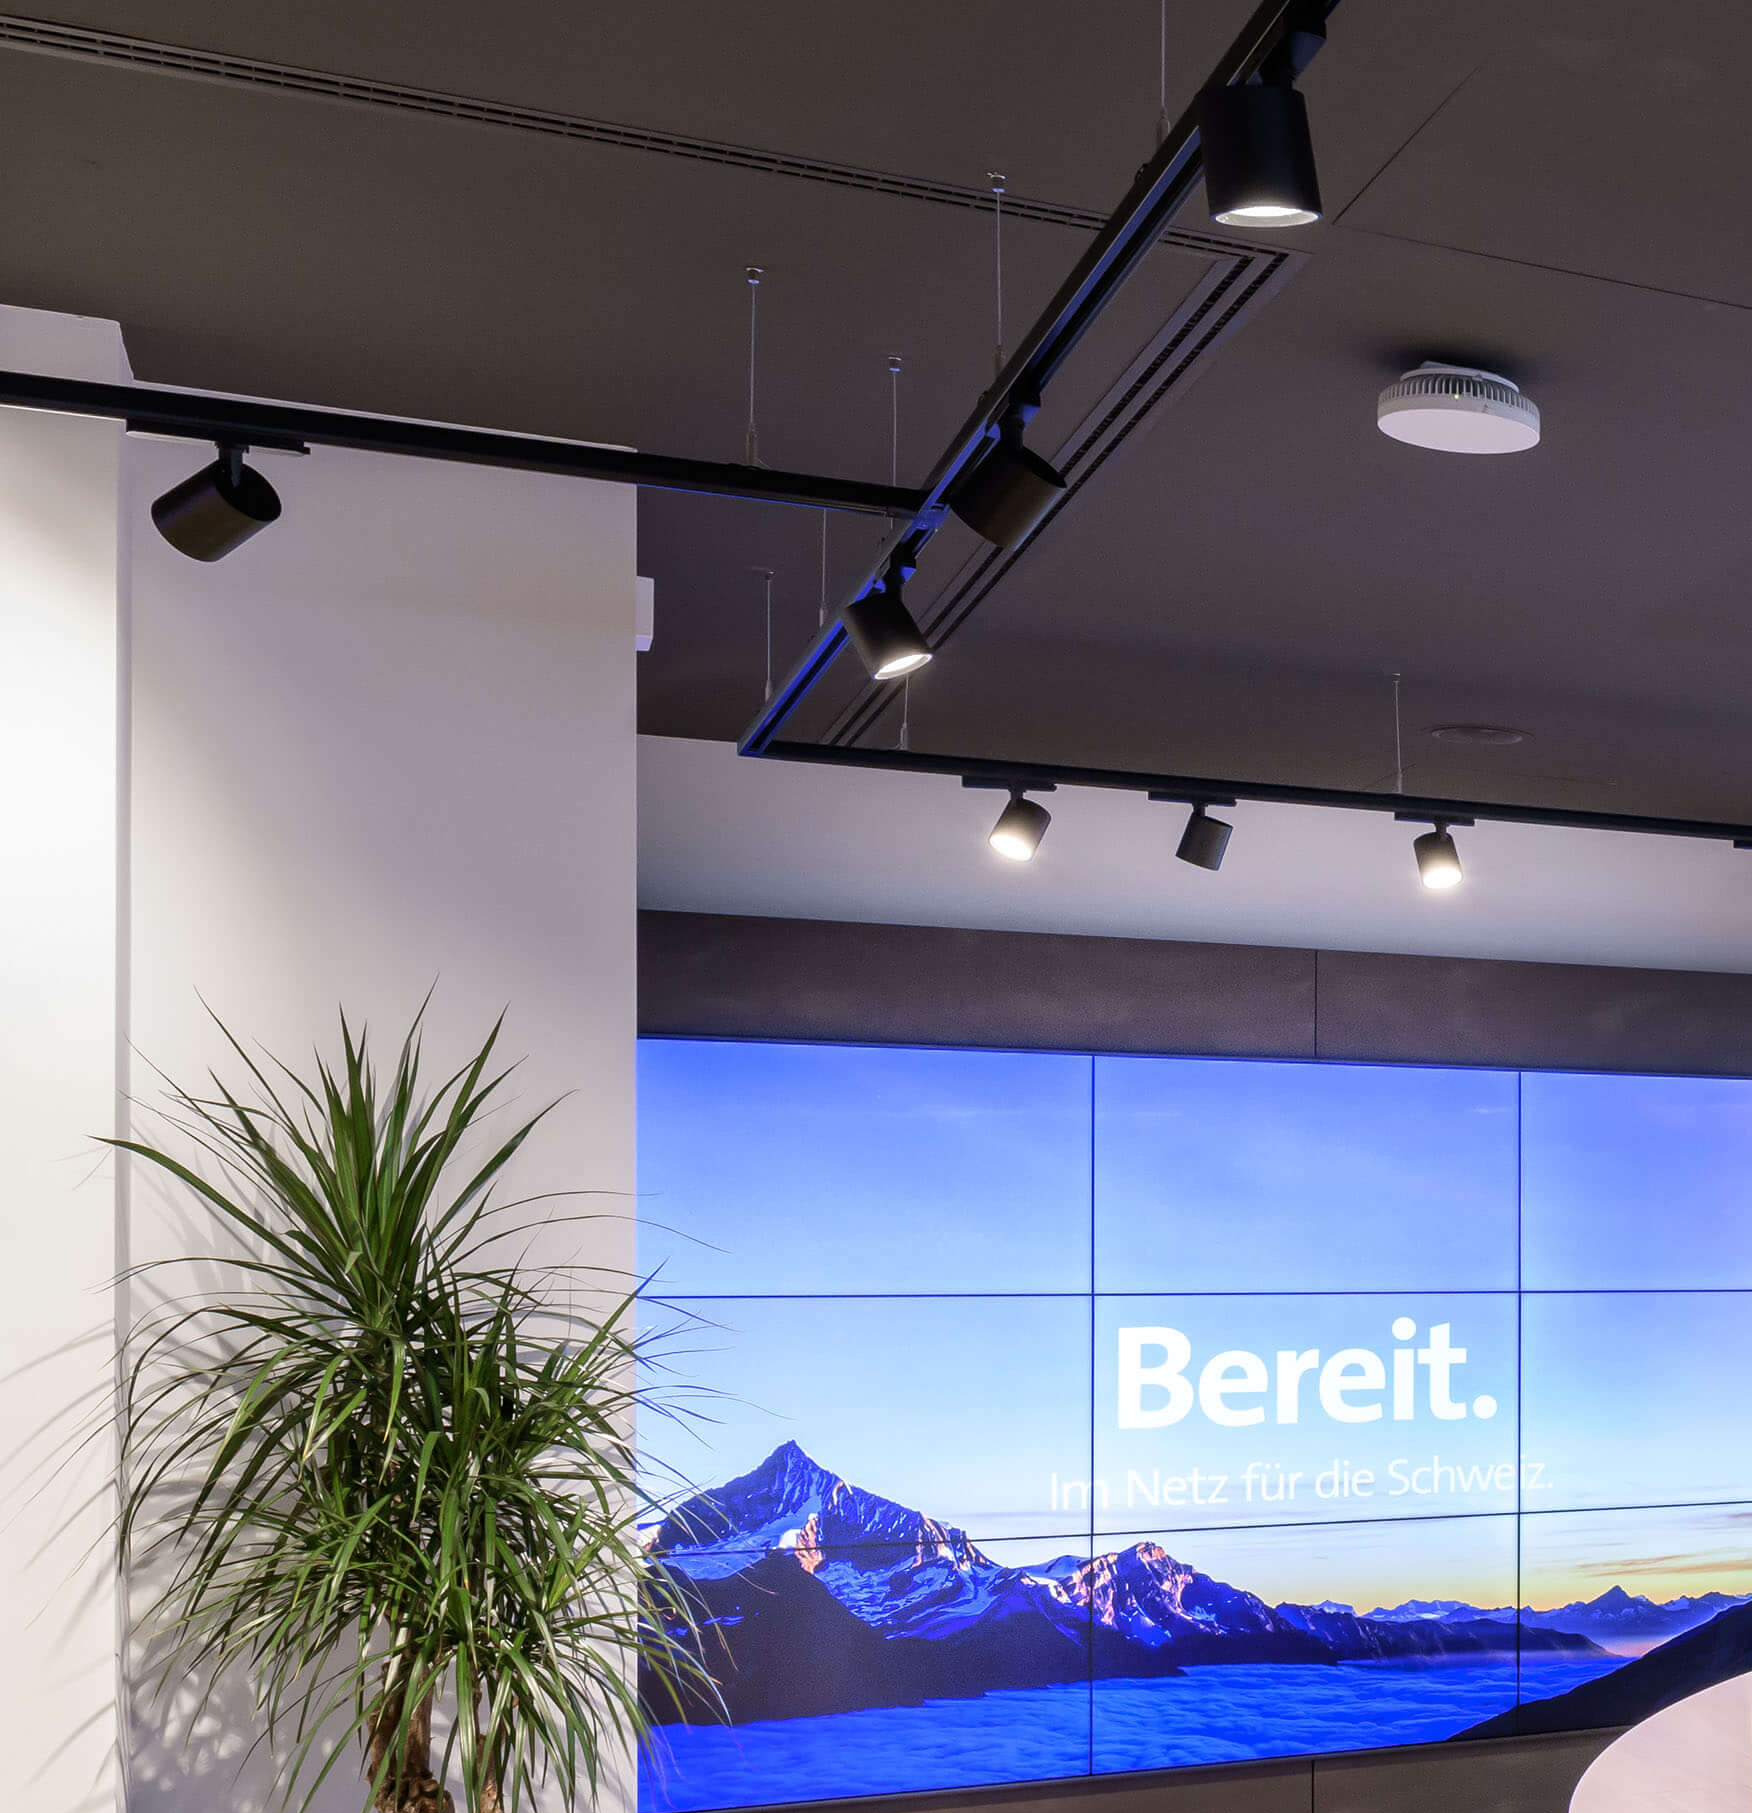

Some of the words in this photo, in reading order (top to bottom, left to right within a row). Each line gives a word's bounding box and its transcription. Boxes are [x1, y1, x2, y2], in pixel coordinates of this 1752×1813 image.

[1116, 1316, 1499, 1430] Bereit.
[1051, 1470, 1109, 1511] Im
[1127, 1464, 1228, 1508] Netz
[1241, 1461, 1303, 1503] für
[1314, 1459, 1374, 1499] die
[1387, 1453, 1553, 1496] Schweiz.
